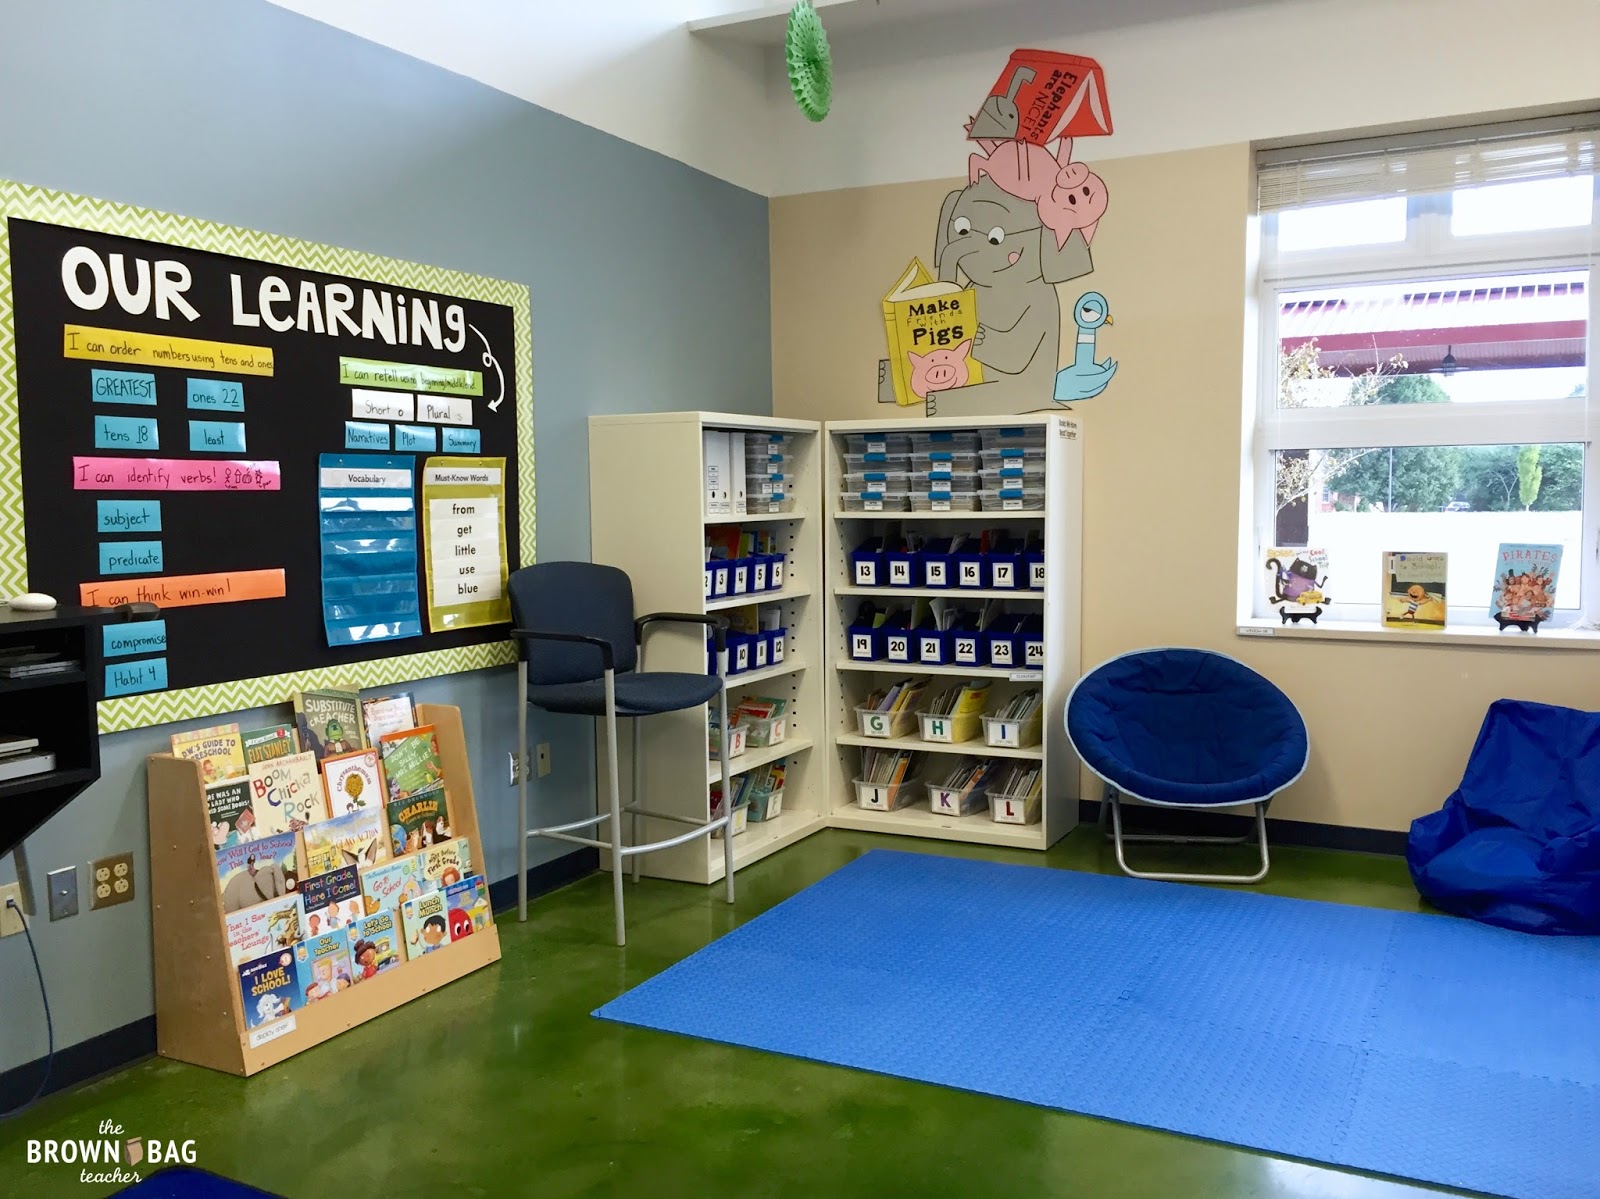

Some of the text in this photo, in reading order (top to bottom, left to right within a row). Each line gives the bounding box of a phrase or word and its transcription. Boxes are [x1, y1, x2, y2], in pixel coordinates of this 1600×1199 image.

[1021, 69, 1063, 130] are NICE!
[1030, 71, 1078, 140] Elephants
[61, 246, 201, 322] OUR
[908, 300, 960, 317] Make
[906, 309, 963, 327] Friends
[919, 318, 946, 327] with
[912, 325, 964, 346] Pigs
[67, 332, 80, 350] I
[87, 341, 104, 354] can
[110, 339, 141, 356] order
[152, 345, 190, 362] numbers
[191, 350, 215, 368] using
[220, 351, 238, 365] tens
[240, 355, 255, 368] and
[342, 363, 349, 378] I
[354, 370, 369, 379] can
[374, 368, 398, 382] retell
[400, 375, 417, 385] using
[96, 377, 155, 399] GREATEST
[192, 389, 240, 406] ones 22
[365, 399, 404, 417] Short o
[427, 404, 451, 420] Plural
[104, 425, 149, 443] tens 18
[204, 429, 225, 445] least
[348, 429, 389, 445] Narratives
[402, 432, 416, 446] Plot
[448, 434, 477, 452] Summary
[78, 464, 217, 488] I can identify verbs!
[348, 474, 386, 485] Vocabulary
[434, 474, 489, 483] Must-Know Words
[452, 504, 475, 515] from
[104, 507, 150, 530] subject
[457, 525, 472, 537] get
[454, 545, 476, 557] little
[1503, 550, 1558, 562] PIRATES
[108, 550, 160, 571] predicate
[459, 565, 475, 575] use
[738, 571, 743, 584] 4
[758, 568, 763, 581] 5
[775, 567, 780, 578] 6
[860, 565, 871, 576] 13
[894, 565, 905, 576] 14
[930, 565, 941, 576] 15
[964, 566, 975, 578] 16
[998, 567, 1008, 579] 17
[1035, 567, 1045, 579] 18
[719, 573, 724, 585] 3
[87, 578, 231, 607] I can think win-win!
[457, 583, 478, 595] blue
[111, 634, 167, 650] compromise
[776, 641, 782, 653] 12
[857, 639, 867, 650] 19
[890, 641, 905, 652] 20
[925, 642, 936, 654] 21
[958, 643, 973, 654] 22
[739, 648, 746, 661] 10
[994, 645, 1009, 656] 23
[1028, 645, 1044, 657] 24
[113, 666, 157, 689] Habit 4
[305, 699, 356, 713] SUBSTITUTE
[309, 713, 356, 727] CREACHER
[775, 718, 783, 737] C
[870, 716, 884, 731] G
[932, 720, 944, 735] H
[1001, 725, 1006, 740] I
[202, 739, 223, 750] GUIDE
[226, 739, 236, 747] TO
[411, 737, 421, 749] BE
[734, 733, 741, 750] B
[248, 739, 291, 763] FLAT STANLEY
[336, 764, 372, 792] Chrysanthemum
[216, 788, 242, 800] WAS AN
[871, 788, 879, 804] J
[940, 792, 951, 808] K
[211, 796, 241, 808] LADY WHO
[771, 795, 778, 811] F
[1006, 801, 1015, 816] L
[399, 801, 438, 823] CHARLIE
[228, 849, 243, 860] Will
[248, 844, 260, 853] Get
[270, 840, 293, 850] School
[228, 852, 277, 870] This Year?
[427, 856, 460, 875] First Grade
[305, 880, 323, 892] First
[305, 892, 325, 904] Here
[327, 889, 331, 898] I
[332, 880, 357, 894] Come!
[373, 881, 382, 892] Go
[382, 877, 402, 898] School
[419, 896, 441, 909] Lunch
[250, 912, 266, 922] Saw
[419, 903, 443, 918] Munch
[363, 919, 379, 929] Let's
[363, 921, 392, 937] to School
[229, 929, 260, 946] eachers'
[241, 935, 269, 950] Lounge
[320, 936, 332, 945] Our
[314, 942, 340, 956] Teacher
[254, 967, 285, 985] I LOVE
[251, 975, 291, 996] SCHOOL!
